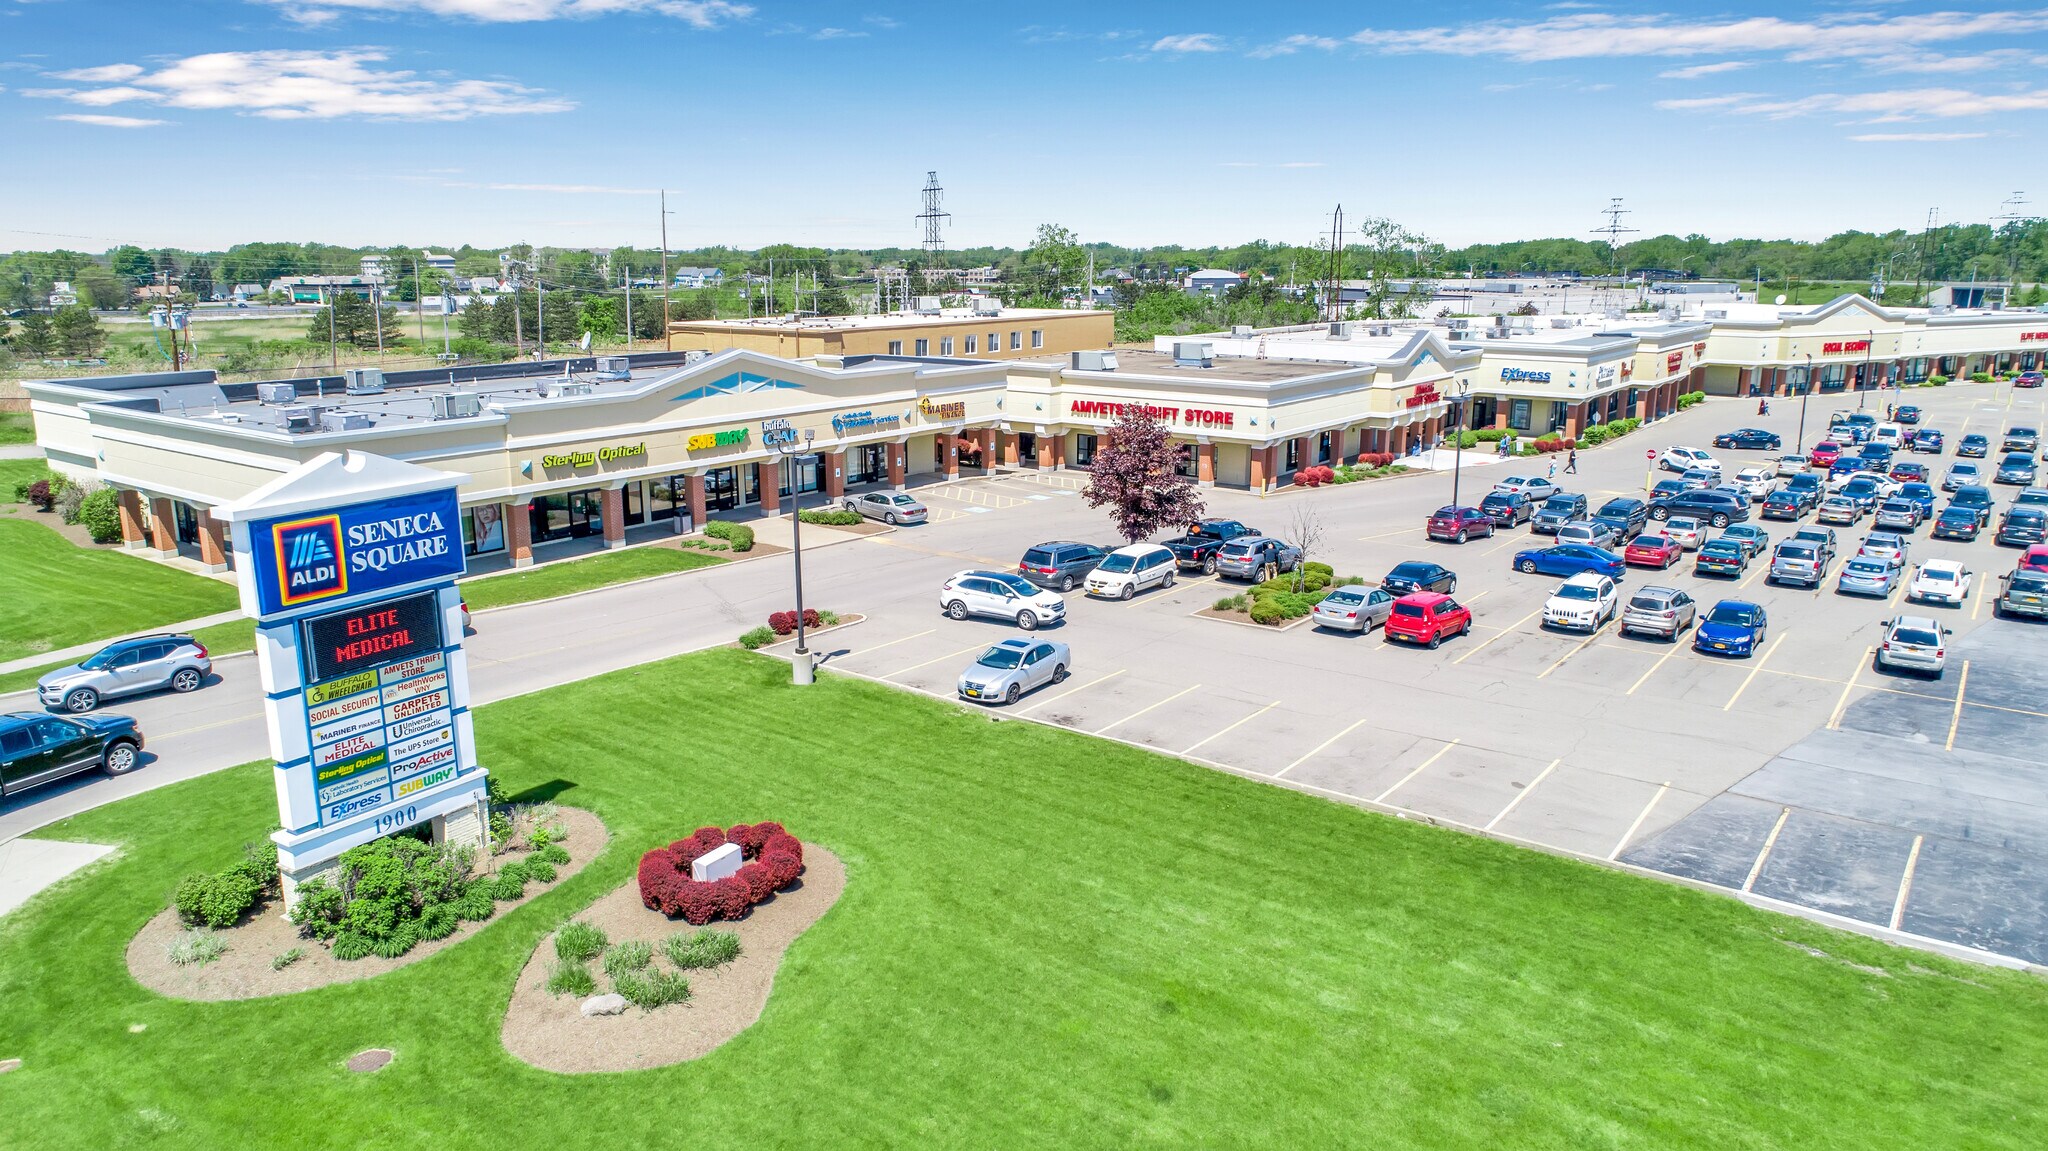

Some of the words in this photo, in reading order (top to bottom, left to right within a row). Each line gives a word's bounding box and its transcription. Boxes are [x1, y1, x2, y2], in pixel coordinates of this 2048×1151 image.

[1501, 367, 1551, 381] Express
[927, 402, 965, 415] MARINER
[940, 410, 965, 420] FINANCE
[1071, 400, 1123, 416] AMVETS
[1184, 409, 1234, 425] STORE
[761, 418, 791, 431] buffalo
[686, 427, 749, 452] SUBWAY
[762, 429, 798, 446] CAP
[542, 451, 595, 468] Sterling
[599, 442, 646, 461] Optical
[348, 511, 445, 548] SENECA
[351, 535, 449, 574] SQUARE
[291, 565, 336, 587] ALDI
[346, 609, 399, 637] ELITE
[335, 629, 414, 663] MEDICAL
[384, 660, 414, 675] AMVETS
[415, 652, 441, 666] THRIFT
[401, 665, 426, 679] STORE
[328, 680, 373, 700] WHEELCHAIR
[329, 672, 371, 690] BUFFALO
[397, 672, 446, 692] HealthWorks
[414, 684, 431, 694] WNY
[310, 707, 340, 723] SOCIAL
[341, 695, 379, 713] SECURITY
[393, 692, 441, 713] CARPETS
[394, 700, 442, 720] UNLIMITED
[320, 725, 357, 741] MARINER
[358, 719, 381, 730] FINANCE
[402, 715, 433, 730] Universal
[403, 719, 441, 736] Chiropractic
[324, 740, 377, 763] MEDICAL
[334, 735, 365, 751] ELITE
[394, 747, 407, 757] The
[407, 741, 422, 752] UPS
[422, 736, 440, 748] Store
[318, 764, 355, 780] Sterling
[355, 752, 384, 768] Optical
[393, 748, 453, 775] ProActive
[332, 783, 363, 798] Laboratory
[363, 775, 387, 787] Services
[398, 767, 454, 797] SUBWAY
[330, 792, 382, 820] Express
[373, 805, 417, 835] 1900
